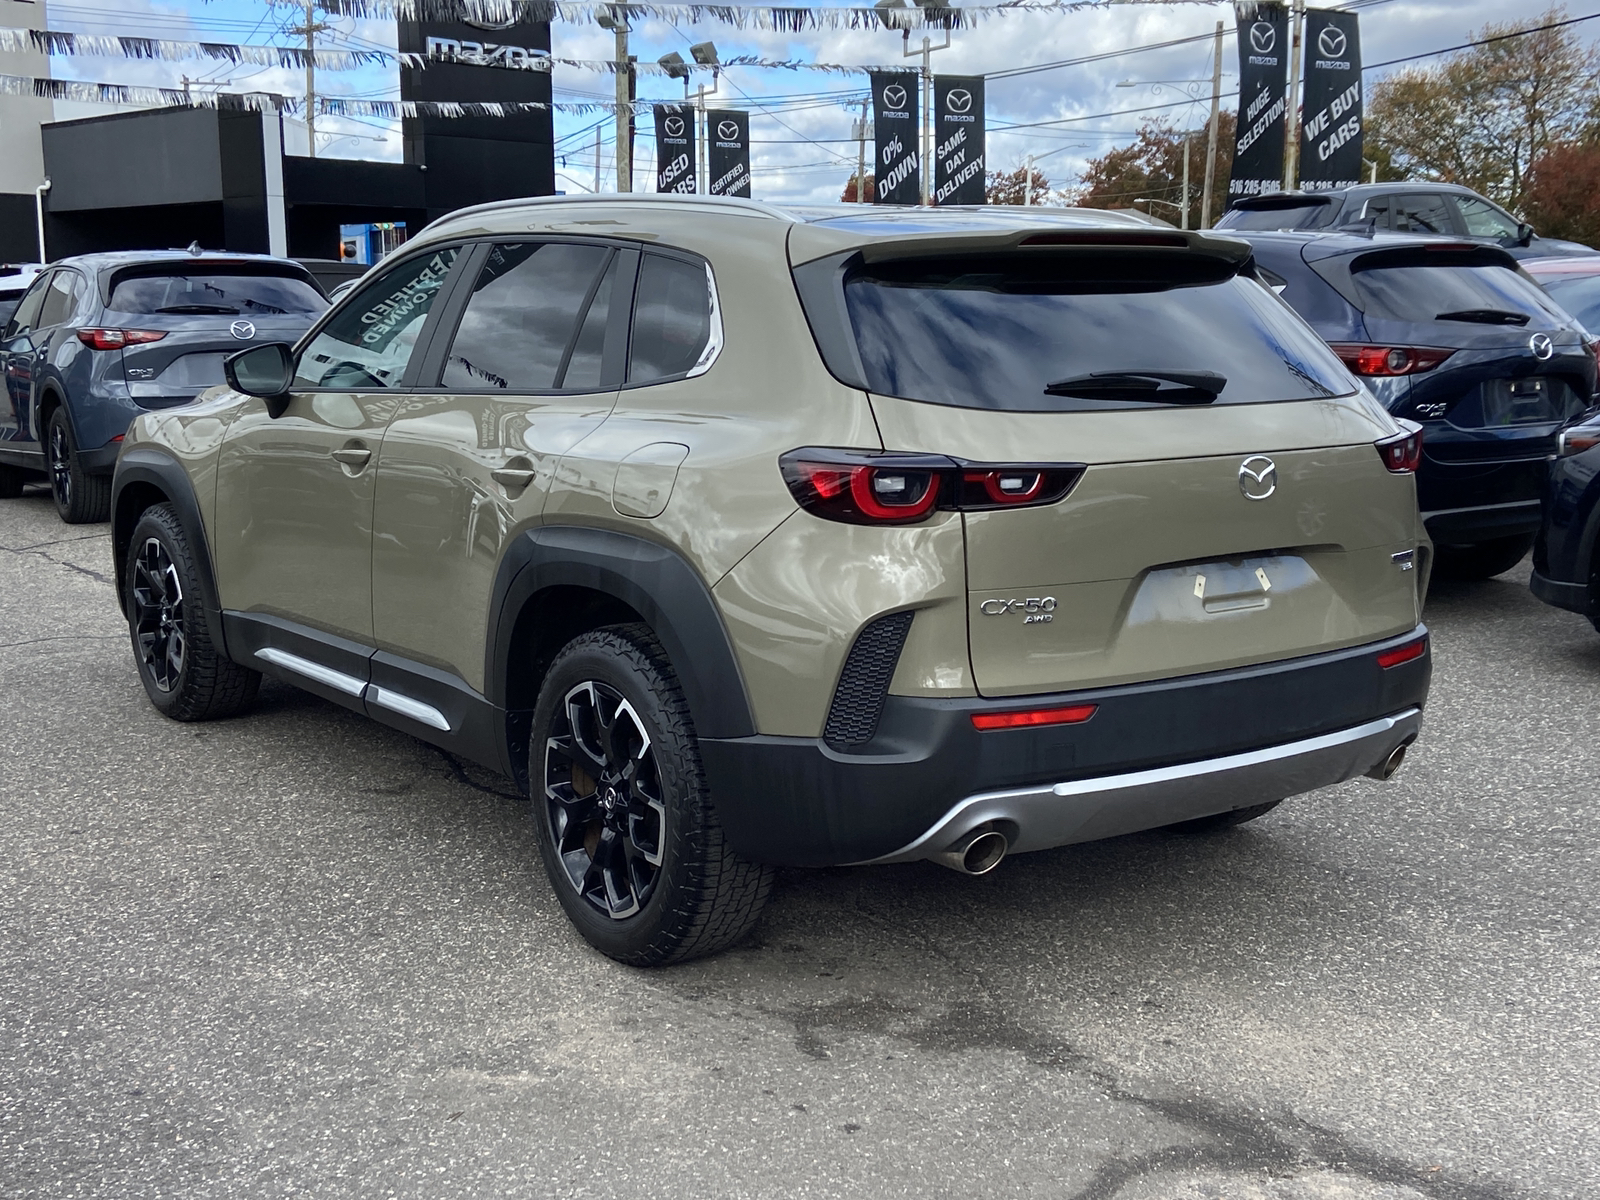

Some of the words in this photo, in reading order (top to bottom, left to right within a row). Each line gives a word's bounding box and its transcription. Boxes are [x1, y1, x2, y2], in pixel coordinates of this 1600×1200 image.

[1249, 55, 1278, 66] mazda
[1315, 60, 1351, 70] mazda
[882, 110, 909, 119] mazda
[944, 114, 975, 122] mazda
[1247, 86, 1271, 123] HUGE
[1304, 108, 1330, 142] WE
[1330, 81, 1360, 121] BUY
[1237, 97, 1284, 157] SELECTION
[1318, 115, 1360, 161] CARS
[716, 141, 741, 149] mazda
[882, 135, 903, 165] 0%
[937, 127, 967, 160] SAME
[659, 153, 689, 189] USED
[878, 151, 918, 200] DOWN
[945, 148, 966, 174] DAY
[711, 163, 744, 194] CERTIFIED
[936, 155, 984, 203] DELIVERY
[1229, 179, 1244, 194] 516
[980, 596, 1057, 615] CX-50
[1023, 614, 1053, 625] AWD
